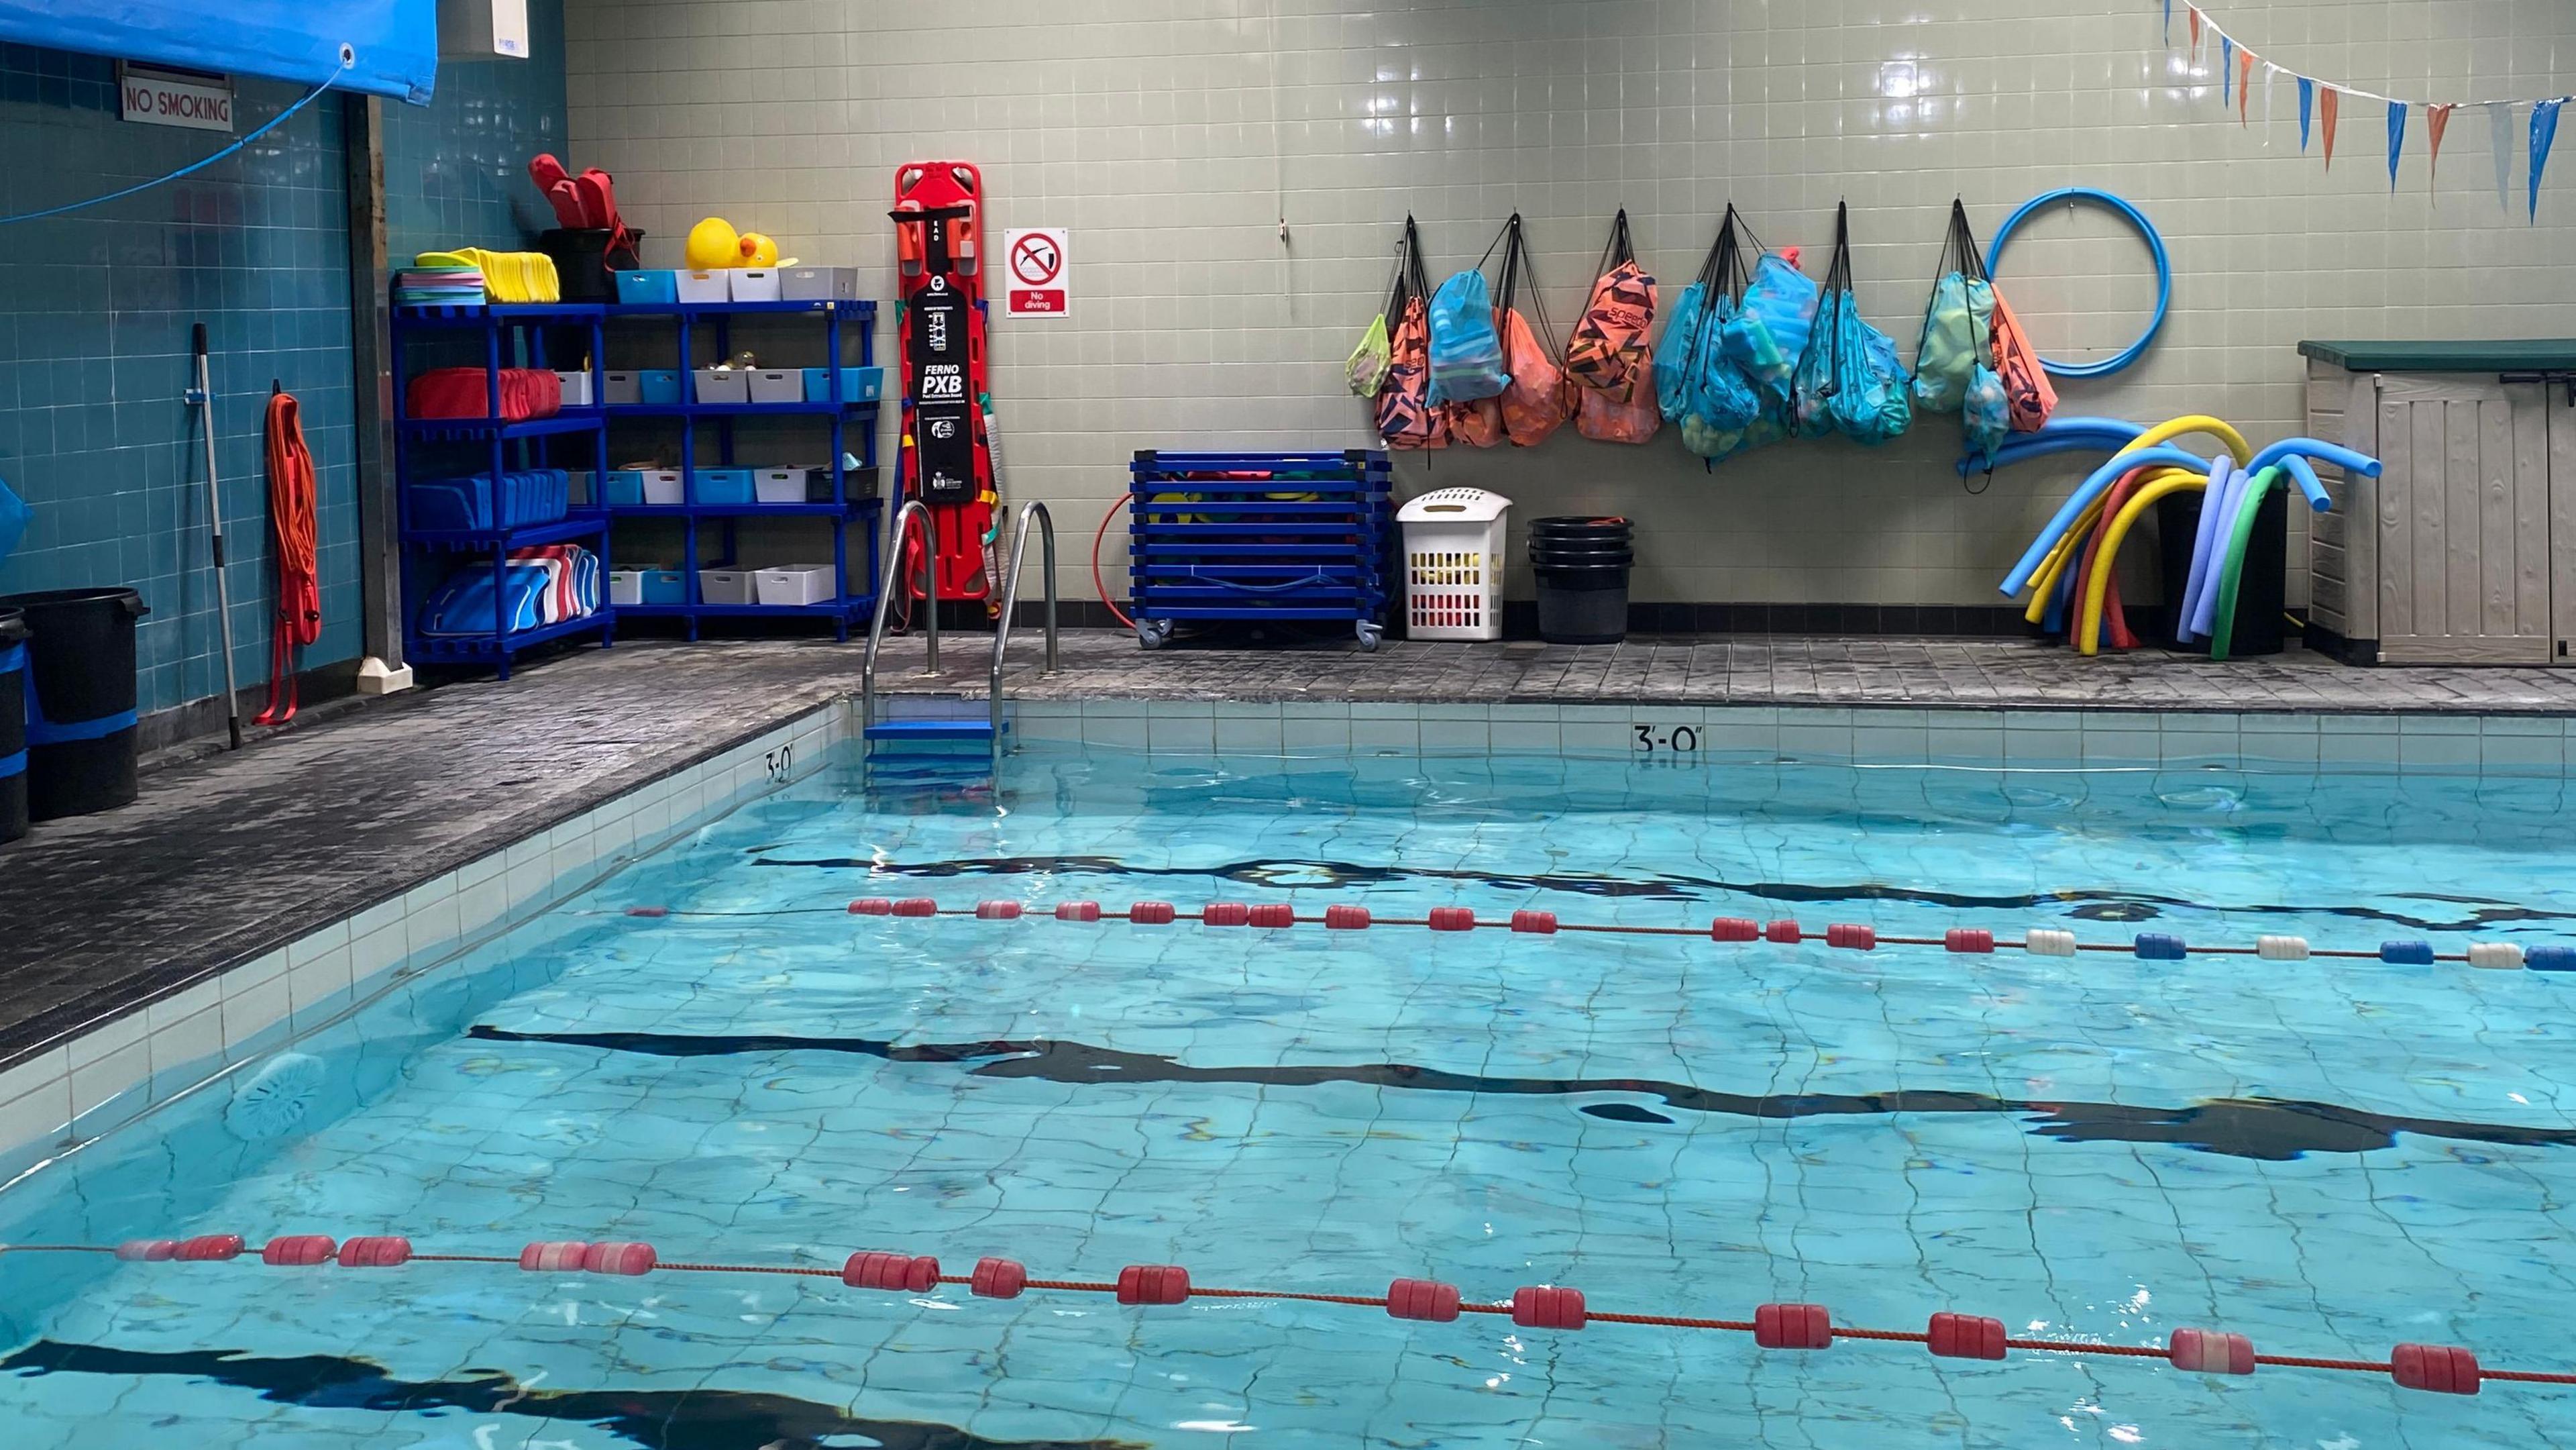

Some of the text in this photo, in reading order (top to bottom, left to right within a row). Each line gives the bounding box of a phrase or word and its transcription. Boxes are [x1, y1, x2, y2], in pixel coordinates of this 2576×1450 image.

[126, 87, 228, 122] NO SMOKING
[1030, 291, 1044, 301] No
[1024, 300, 1051, 311] diving
[925, 364, 959, 375] FERNO
[922, 375, 962, 394] PXB
